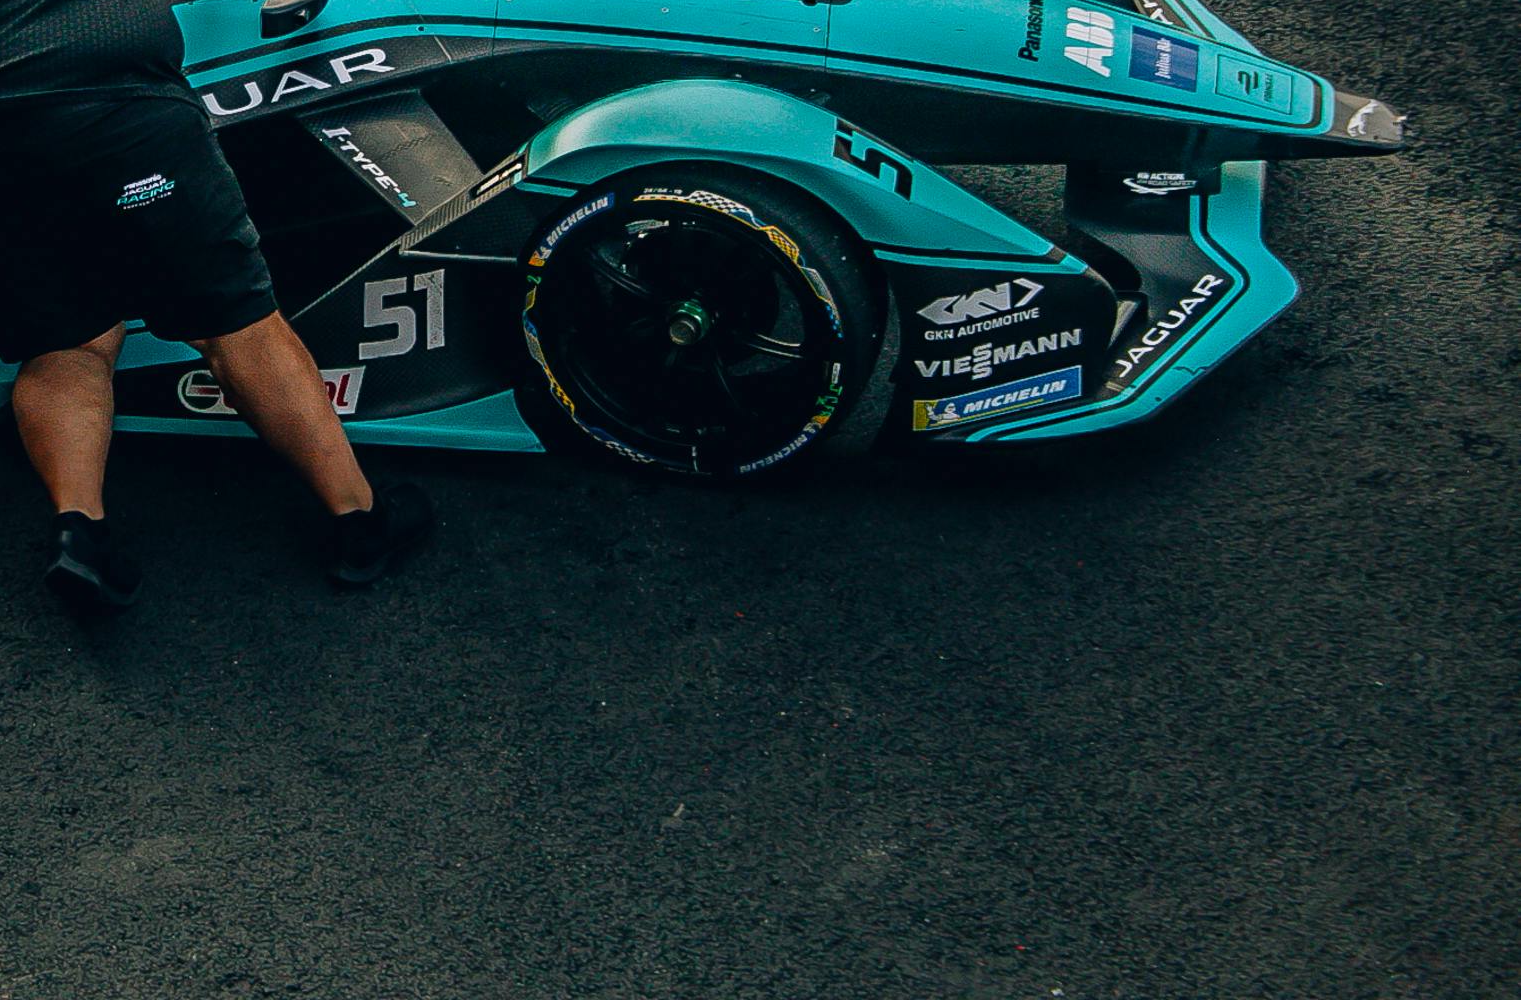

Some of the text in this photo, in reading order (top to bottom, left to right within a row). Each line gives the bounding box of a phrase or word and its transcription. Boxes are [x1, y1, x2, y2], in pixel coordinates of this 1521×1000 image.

[1064, 6, 1115, 78] ABB
[202, 47, 395, 116] UAR
[116, 180, 175, 206] RACING
[321, 126, 417, 208] I-TYPE-4
[546, 195, 609, 247] MICHELIN
[359, 268, 445, 360] 51
[924, 307, 1040, 341] GKN AUTOMOTIVE
[1118, 273, 1224, 377] JAGUAR
[914, 328, 1082, 381] VIESSMANN
[963, 379, 1067, 414] MICHELIN
